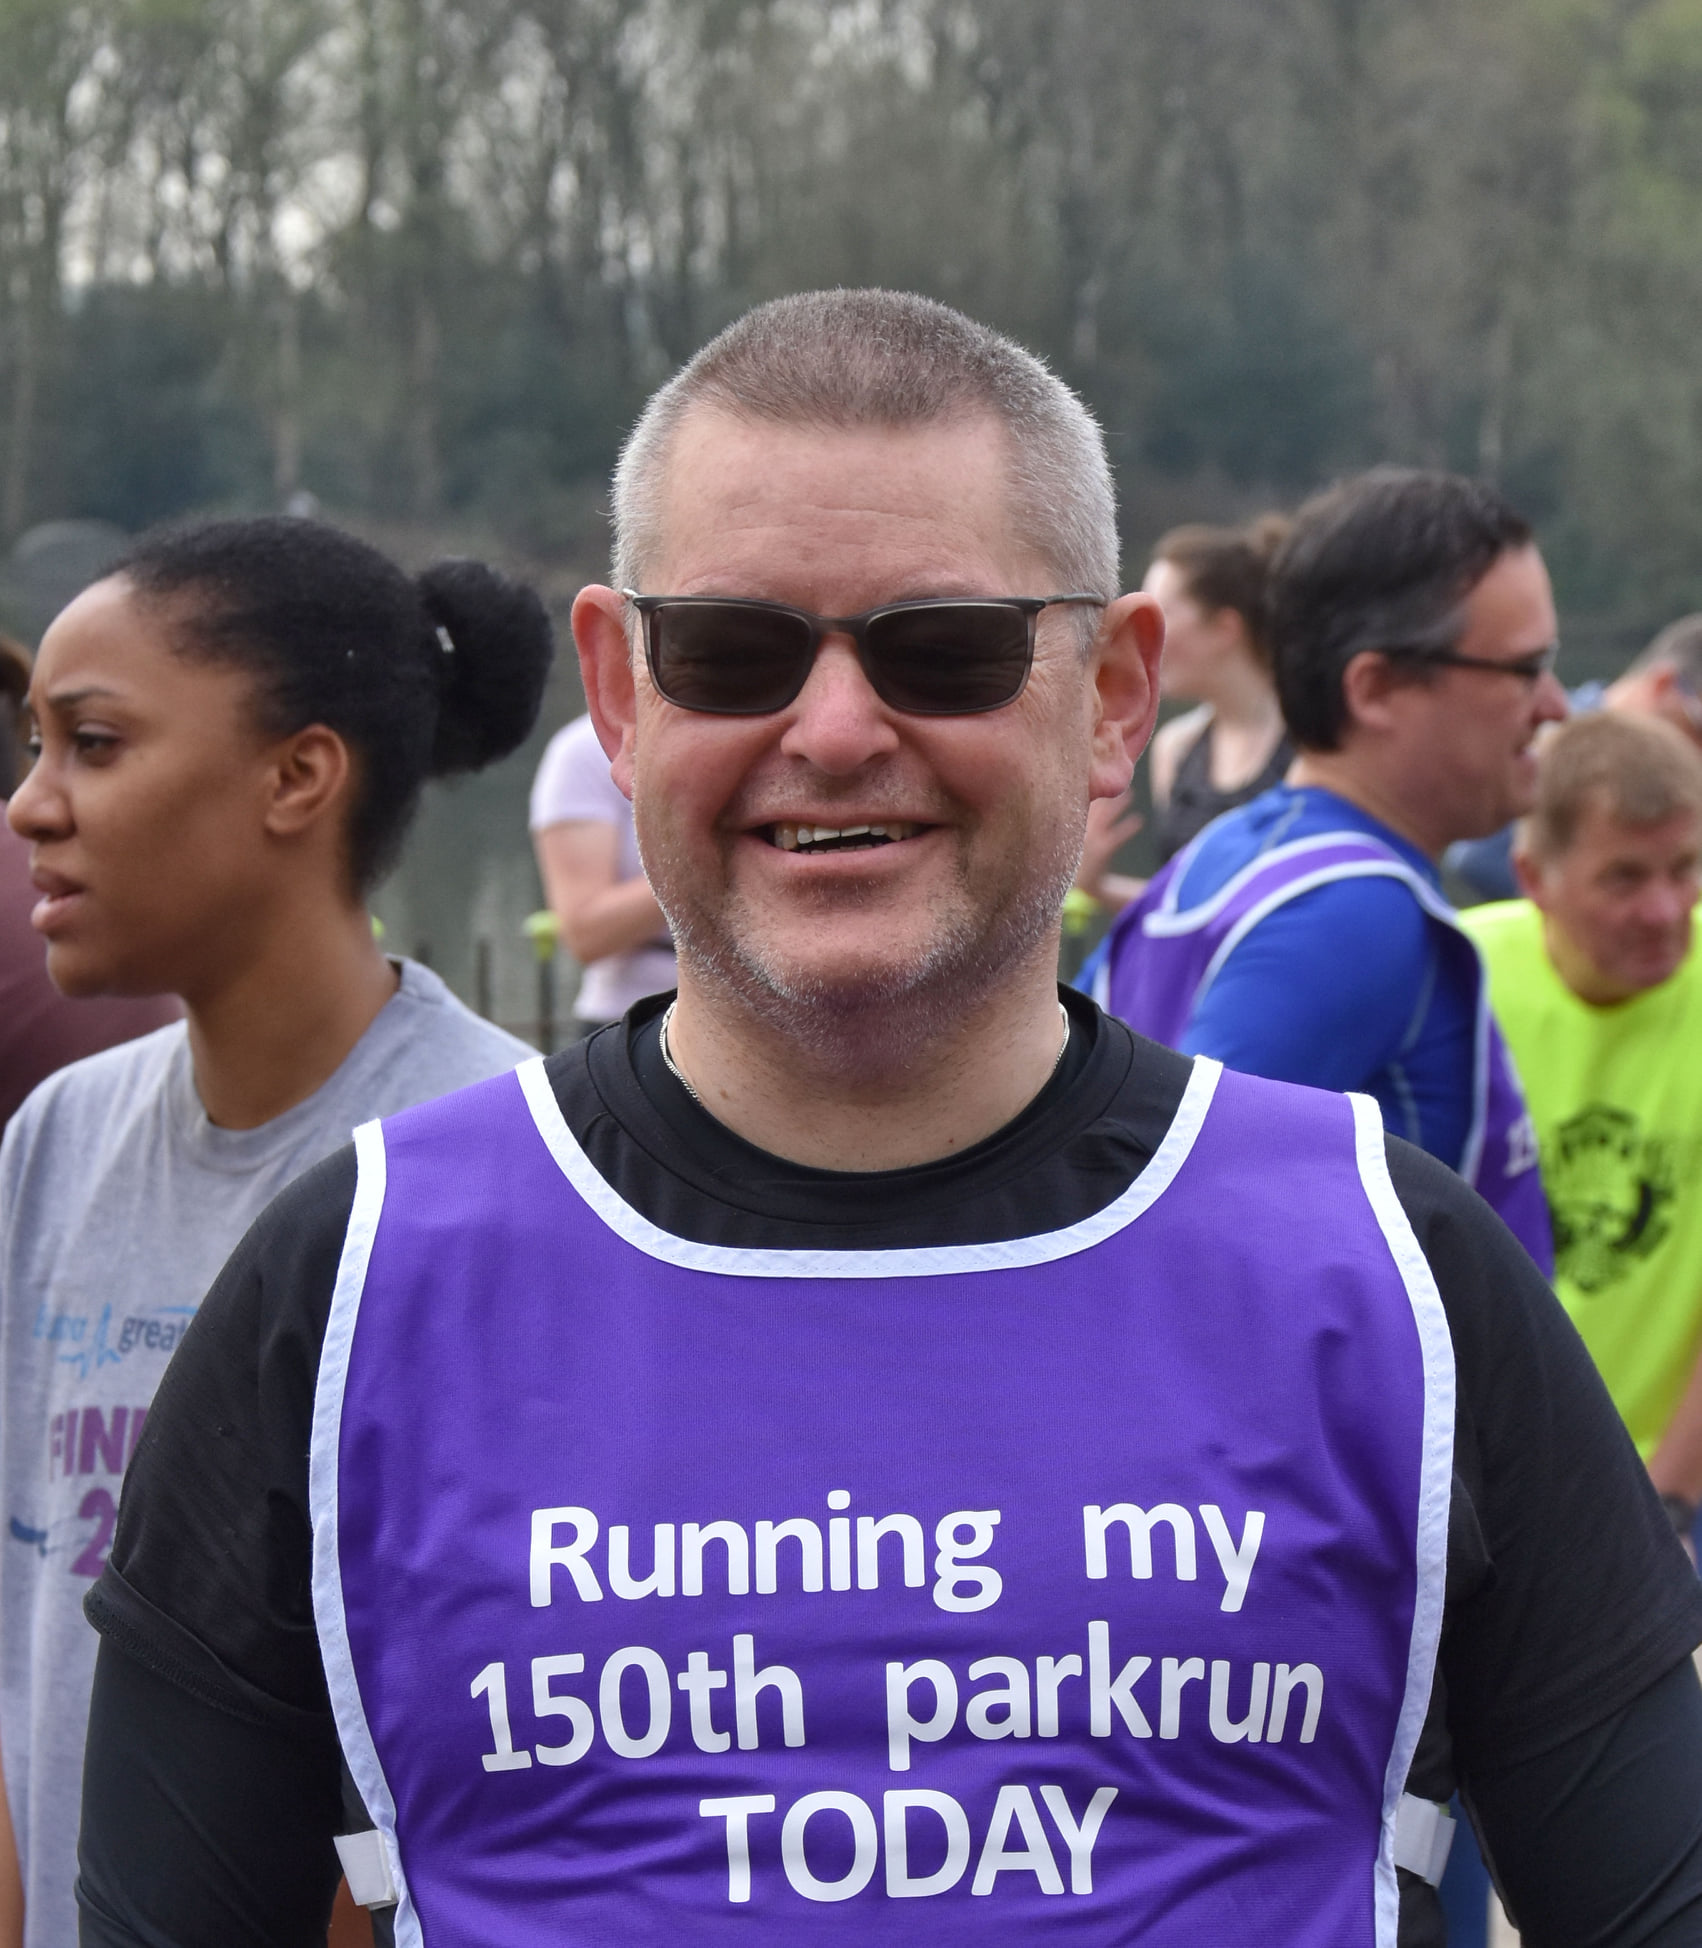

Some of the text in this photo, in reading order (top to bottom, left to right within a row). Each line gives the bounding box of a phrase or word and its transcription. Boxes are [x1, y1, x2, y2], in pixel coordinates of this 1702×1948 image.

[529, 1489, 1266, 1613] Running my
[470, 1620, 1324, 1772] 150th parkrun
[698, 1784, 1119, 1903] TODAY
